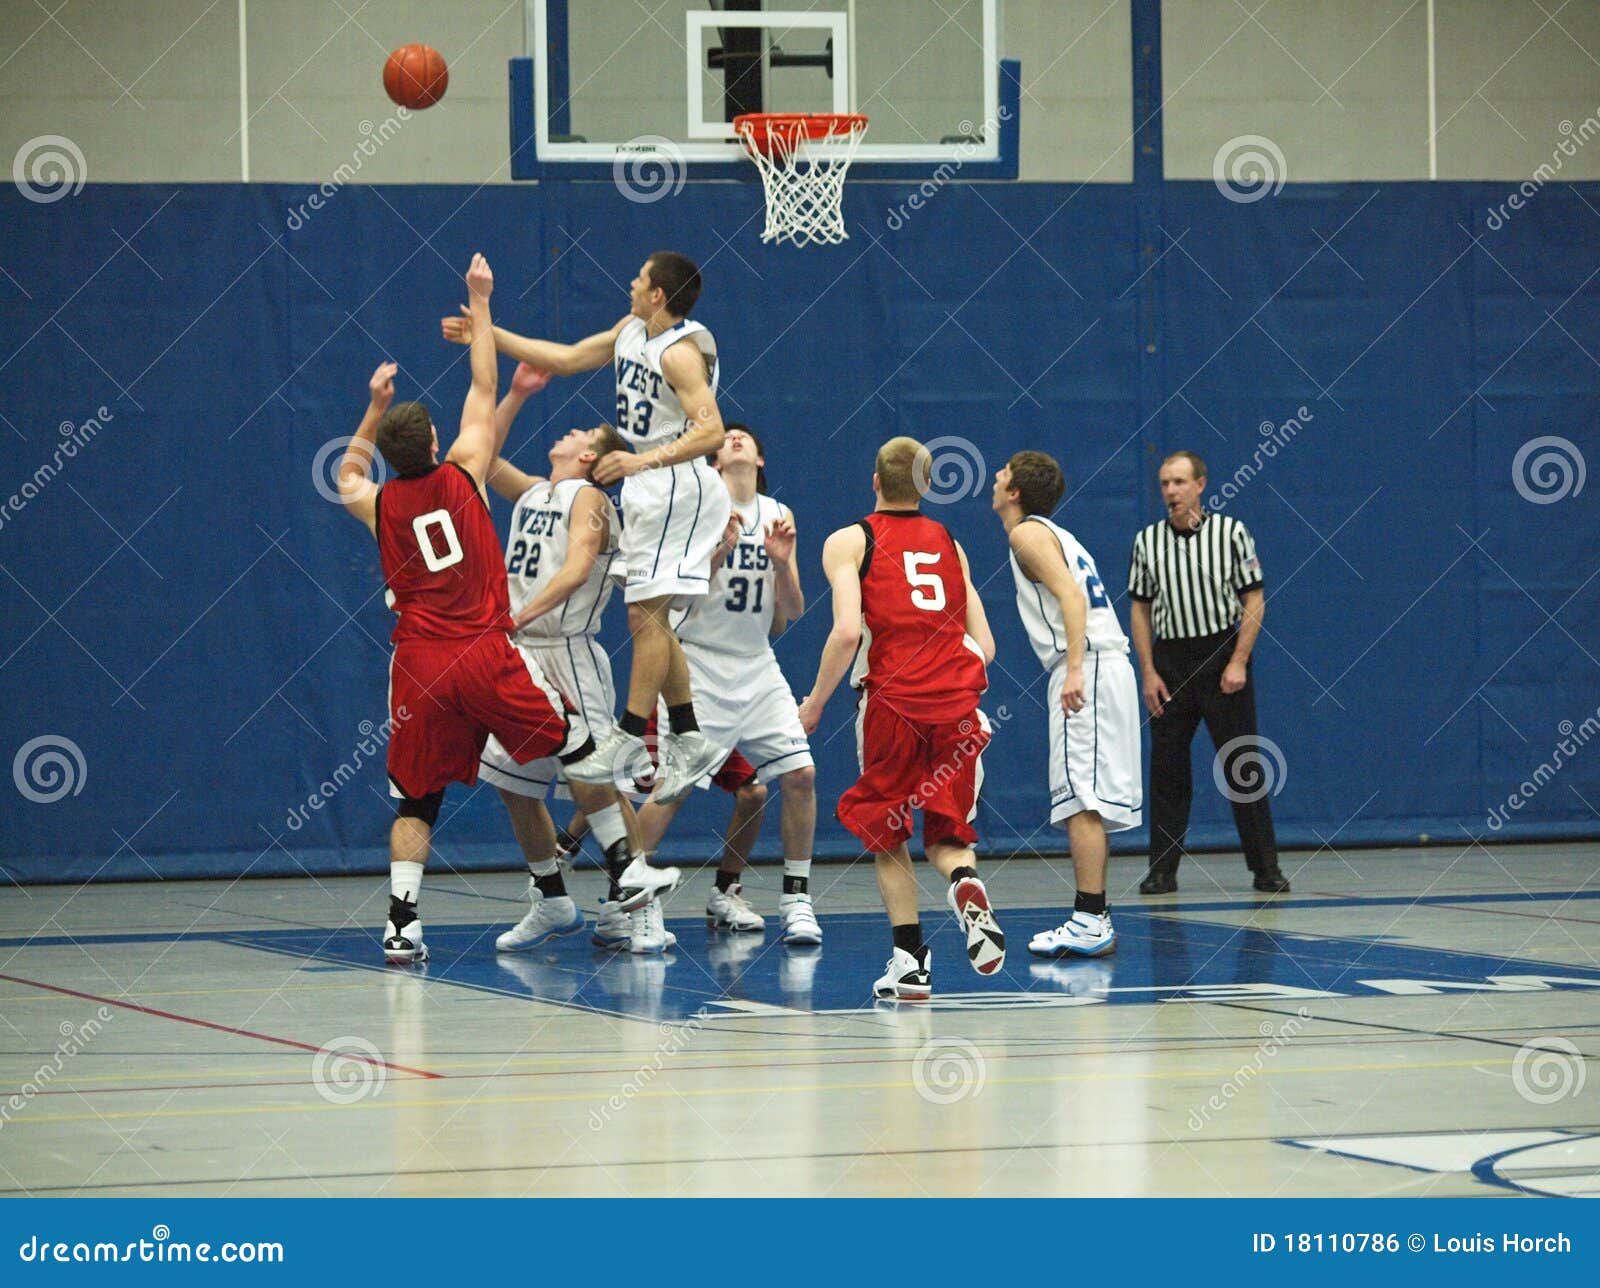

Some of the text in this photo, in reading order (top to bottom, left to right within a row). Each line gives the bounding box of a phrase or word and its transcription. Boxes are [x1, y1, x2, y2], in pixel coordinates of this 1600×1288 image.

[617, 356, 663, 400] WEST
[616, 394, 653, 437] 23
[412, 508, 464, 573] 0
[519, 506, 562, 537] WEST
[508, 540, 541, 578] 22
[725, 576, 764, 613] 31
[902, 551, 946, 612] 5
